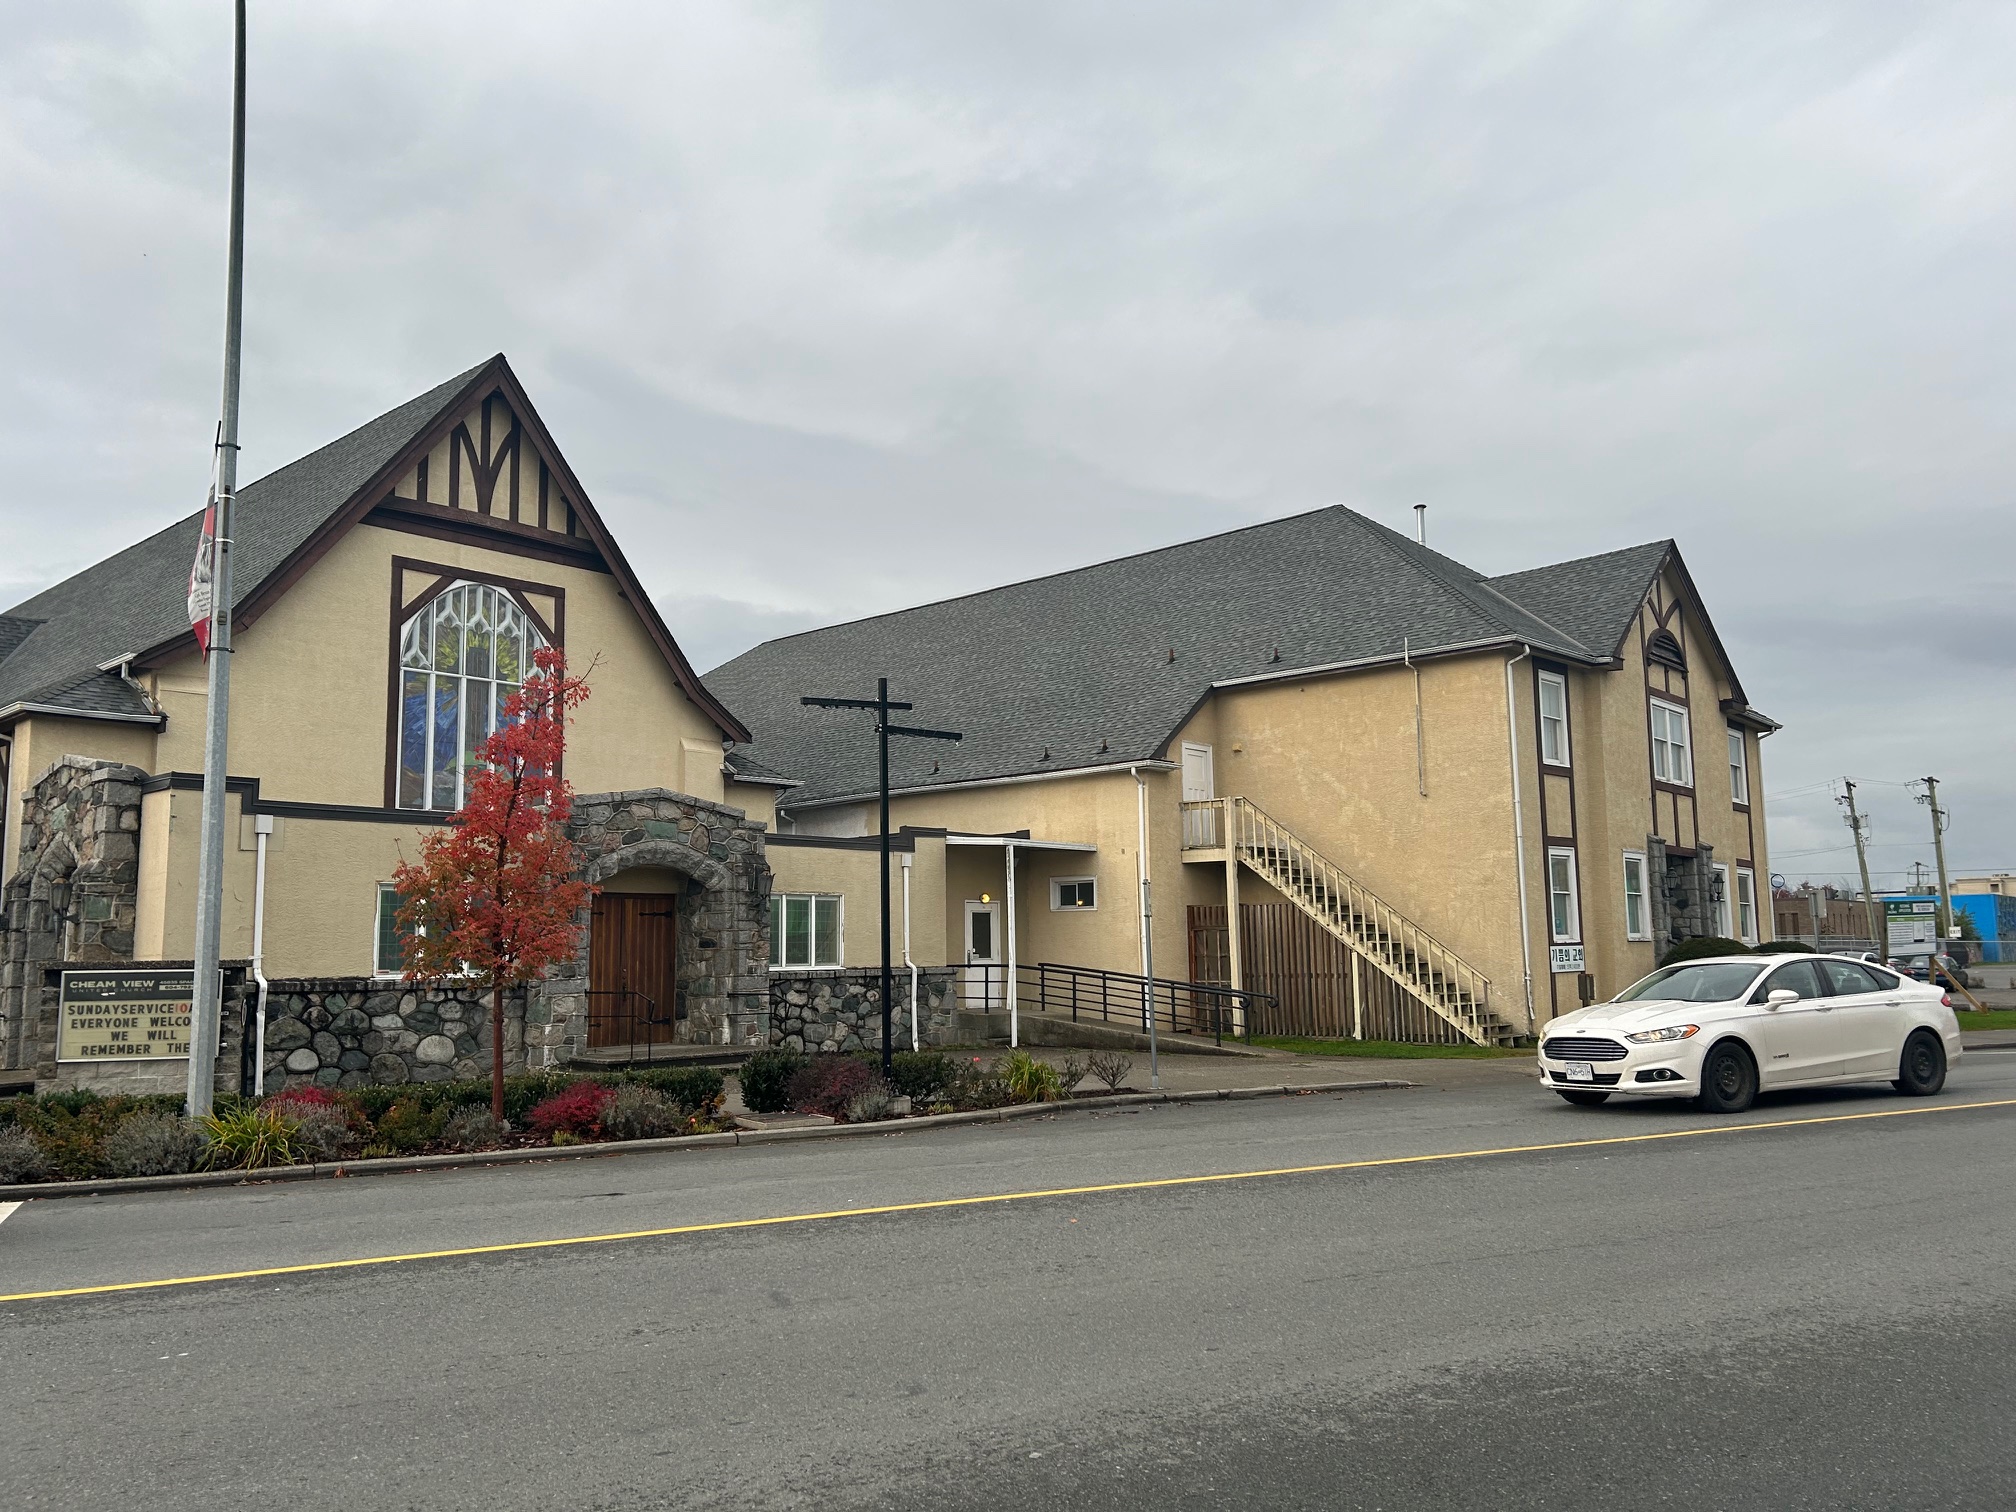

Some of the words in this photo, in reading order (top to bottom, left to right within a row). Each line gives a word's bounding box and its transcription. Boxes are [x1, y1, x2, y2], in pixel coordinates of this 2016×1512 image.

[69, 980, 116, 988] CHEAM
[71, 1017, 138, 1029] EVERYONE
[150, 1016, 191, 1027] WELCO
[111, 1031, 128, 1041] WE
[147, 1030, 177, 1040] WILL
[81, 1043, 151, 1056] REMEMBER
[167, 1043, 190, 1053] THE
